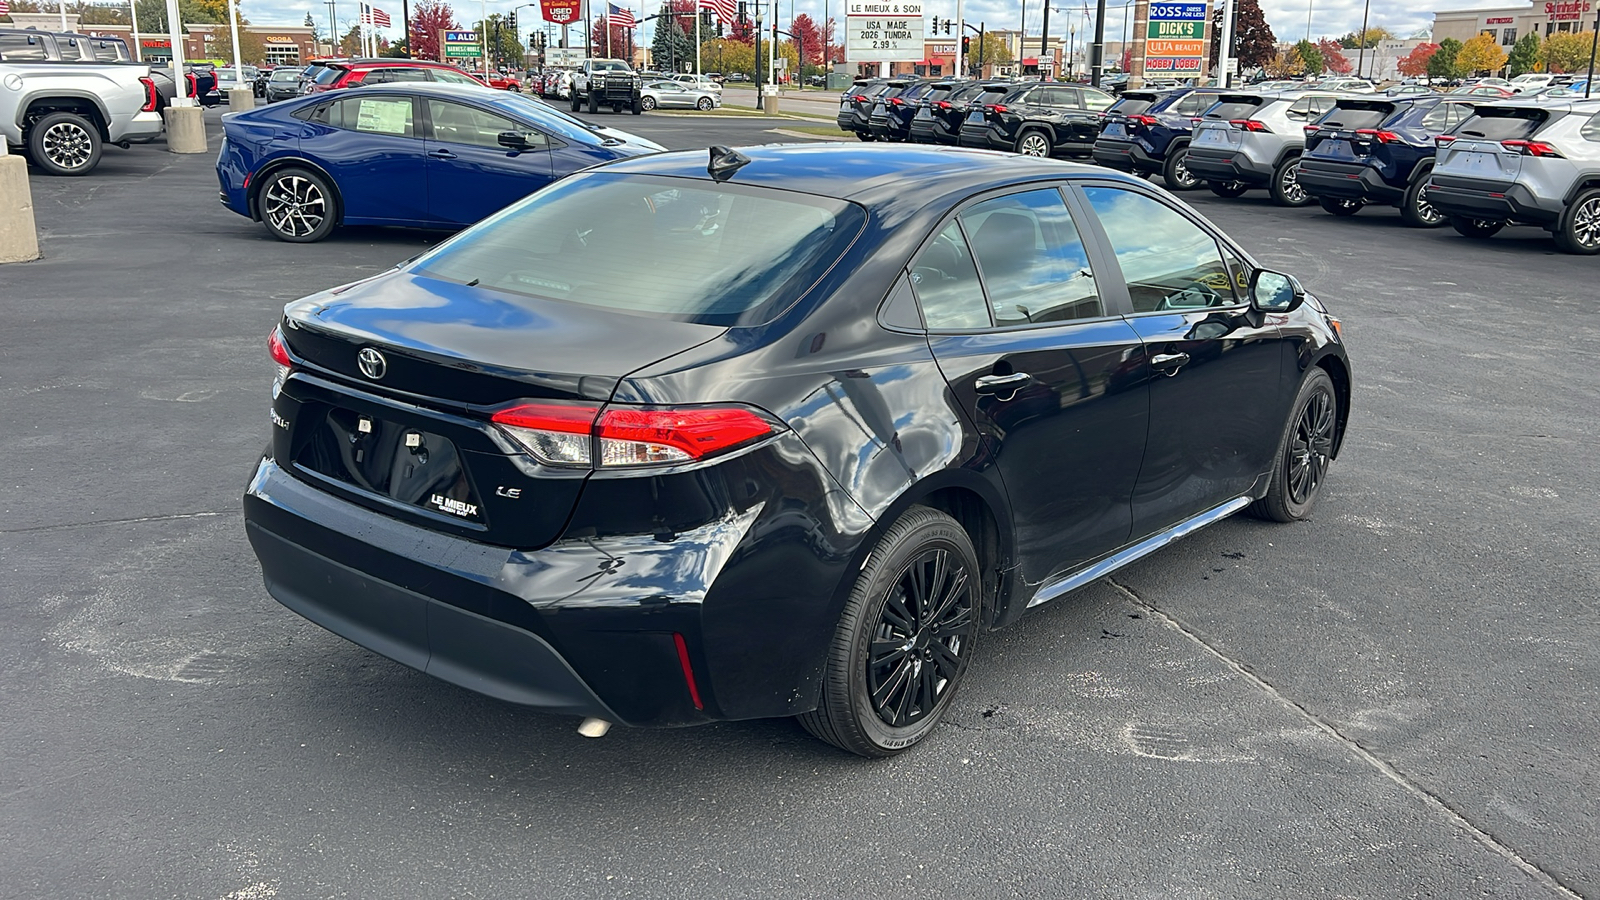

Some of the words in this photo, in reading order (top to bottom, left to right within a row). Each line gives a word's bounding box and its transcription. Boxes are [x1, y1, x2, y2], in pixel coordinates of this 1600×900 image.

[549, 7, 573, 15] USED
[851, 4, 862, 13] LE
[864, 4, 891, 13] MIEUX
[893, 5, 899, 13] &
[902, 5, 921, 13] SON
[1150, 6, 1182, 17] ROSS
[552, 14, 570, 22] CARS
[866, 20, 881, 30] USA
[886, 20, 908, 30] MADE
[1158, 22, 1195, 35] DICK'S
[457, 33, 478, 41] ALDI
[860, 30, 879, 40] 2026
[884, 30, 912, 40] TUNDRA
[872, 40, 890, 50] 2.99
[1150, 41, 1173, 51] ULTA
[1146, 58, 1174, 70] HOBBY
[1174, 58, 1201, 70] LOBBY
[495, 486, 521, 499] LE
[431, 494, 444, 505] LE
[444, 498, 477, 515] MIEUX
